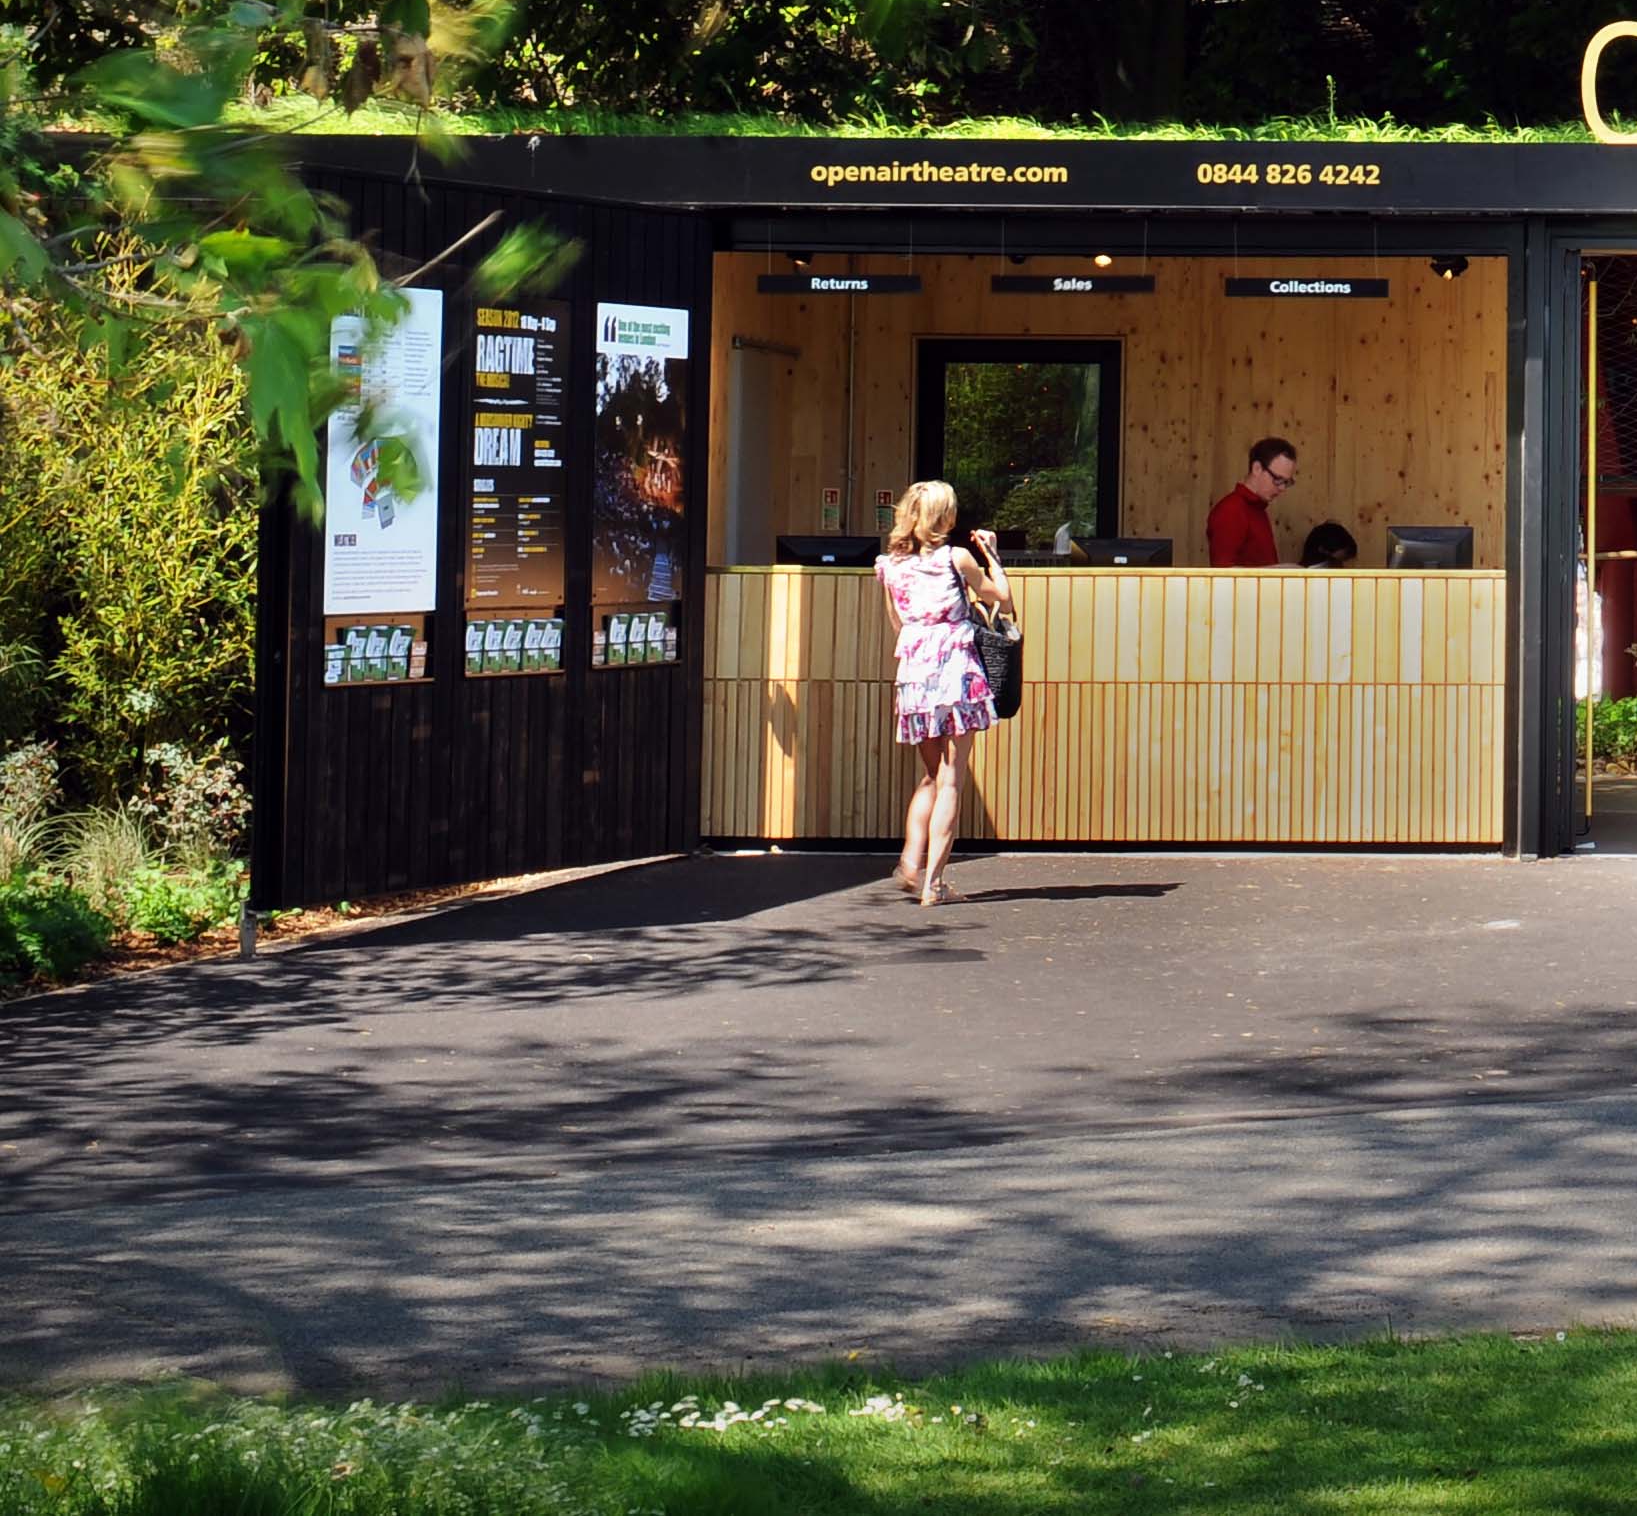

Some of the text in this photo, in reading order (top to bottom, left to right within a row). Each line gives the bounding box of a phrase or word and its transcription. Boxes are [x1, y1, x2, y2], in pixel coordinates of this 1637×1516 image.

[810, 160, 1069, 187] openairtheatre.com
[1196, 163, 1381, 186] 0844 826 4242
[810, 277, 869, 291] Returns
[1052, 277, 1093, 291] Sales
[1269, 280, 1352, 294] Collections
[476, 334, 535, 375] RAGTIME
[473, 427, 522, 466] DREAM
